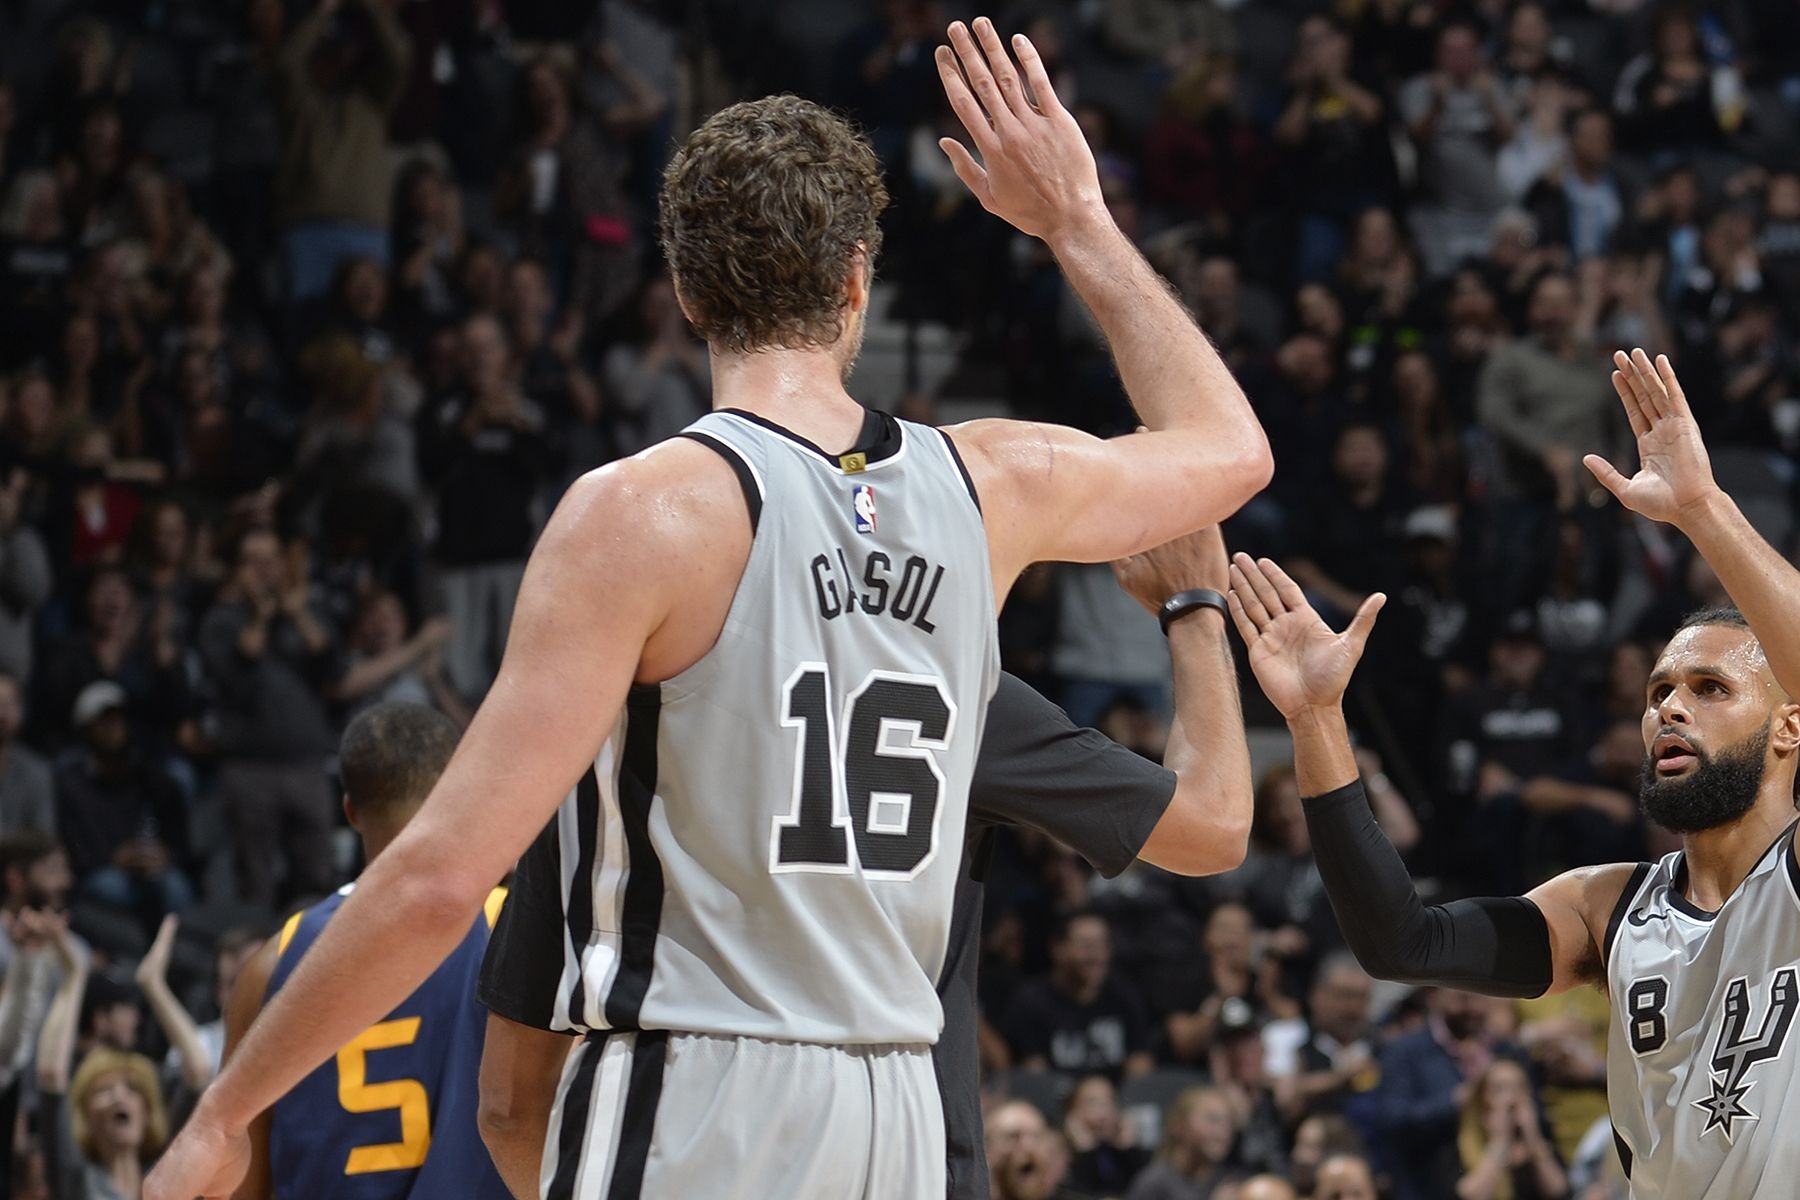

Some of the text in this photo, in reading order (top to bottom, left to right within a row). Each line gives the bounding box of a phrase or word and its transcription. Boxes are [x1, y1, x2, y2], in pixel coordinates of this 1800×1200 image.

[770, 660, 958, 882] 16
[336, 1015, 431, 1177] 5
[1625, 974, 1671, 1059] 8
